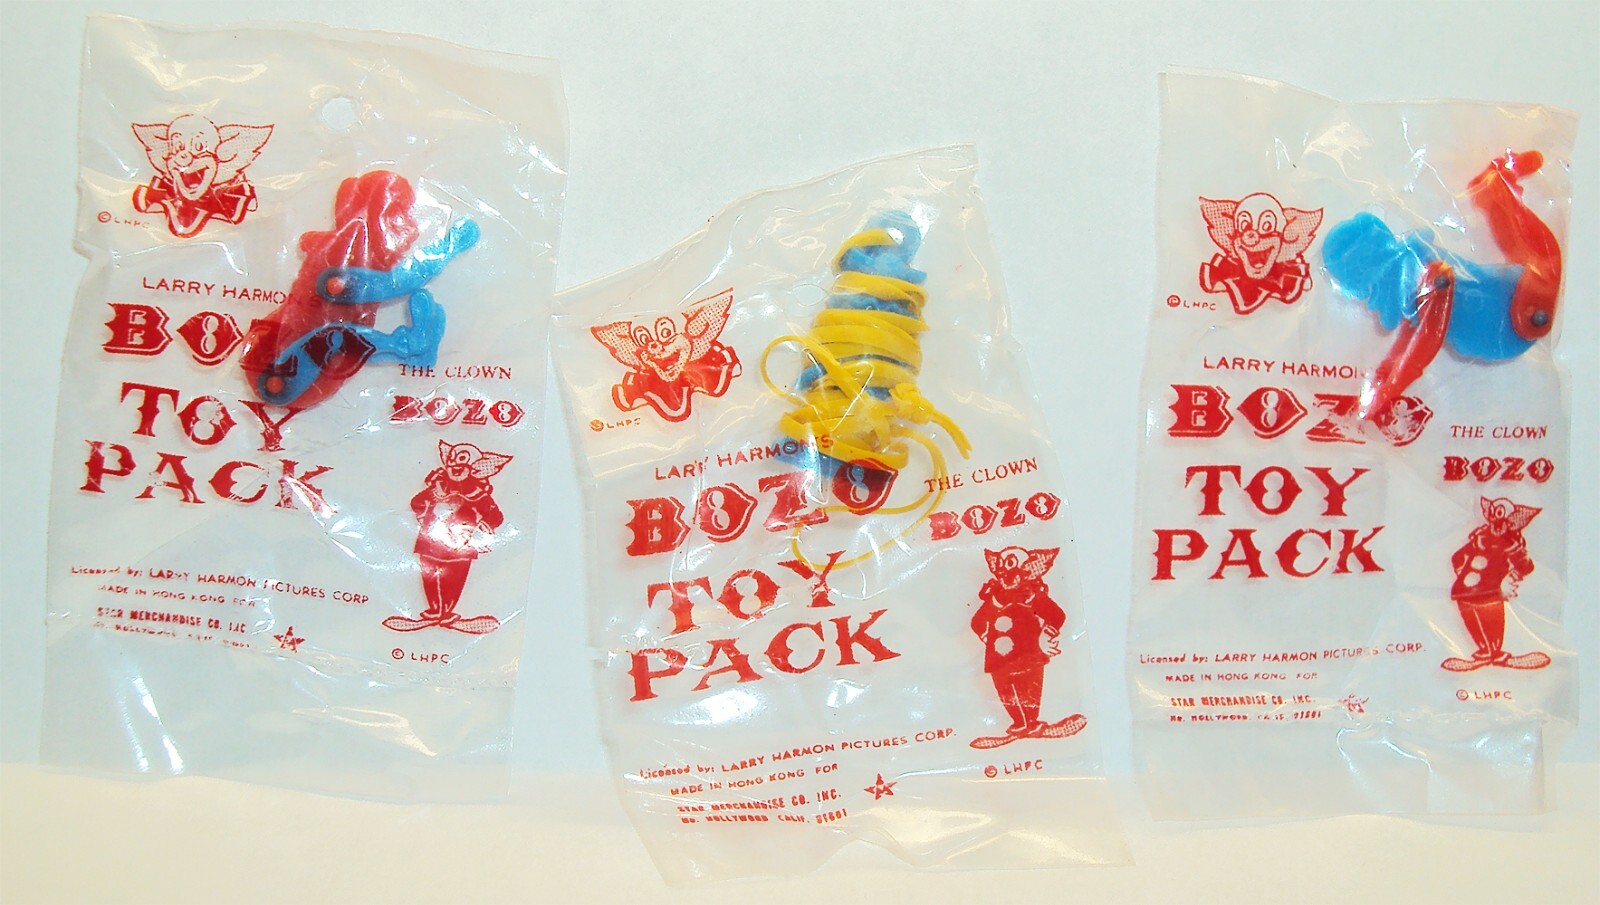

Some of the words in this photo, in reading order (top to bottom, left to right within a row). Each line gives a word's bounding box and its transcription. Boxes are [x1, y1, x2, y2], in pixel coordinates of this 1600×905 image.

[142, 276, 216, 297] LARRY
[102, 302, 377, 381] BOZO
[398, 363, 436, 379] THE
[445, 365, 512, 380] CLOWN
[1203, 355, 1276, 373] LARRY
[120, 381, 305, 452] TOY
[389, 395, 526, 428] BOZO
[1167, 384, 1434, 447] BOZO
[1450, 424, 1485, 439] THE
[1492, 425, 1548, 440] CLOWN
[79, 439, 339, 514] PACK
[924, 473, 964, 493] THE
[971, 457, 1038, 484] CLOWN
[1443, 456, 1555, 483] BOZO
[625, 457, 899, 557] BOZO
[1184, 464, 1372, 517] TOY
[927, 492, 1062, 541] BOZO
[1150, 525, 1386, 581] PACK
[197, 573, 257, 588] HARMON
[647, 549, 847, 636] TOY
[411, 651, 450, 665] LHPC
[625, 608, 902, 702] PACK
[1139, 653, 1187, 665] Licensed
[1192, 653, 1208, 665] by:
[1214, 652, 1257, 664] LARRY
[1262, 650, 1319, 663] HARMON
[1165, 674, 1196, 683] MADE
[1200, 673, 1212, 682] IN
[1216, 672, 1249, 682] HONG
[1253, 671, 1287, 681] KONG
[1170, 696, 1196, 708] STAR
[1200, 694, 1268, 707] MERCHANDISE
[639, 764, 691, 779] Licensed
[696, 764, 715, 774] by:
[721, 755, 765, 773] LARRY
[771, 743, 835, 763] HARMON
[841, 735, 908, 751] PICTURES
[914, 727, 957, 743] CORP.
[1003, 759, 1043, 775] LHPC
[669, 783, 704, 796] MADE
[709, 782, 723, 791] IN
[728, 776, 764, 788] HONG
[769, 768, 805, 782] KONG
[815, 763, 839, 775] FOR
